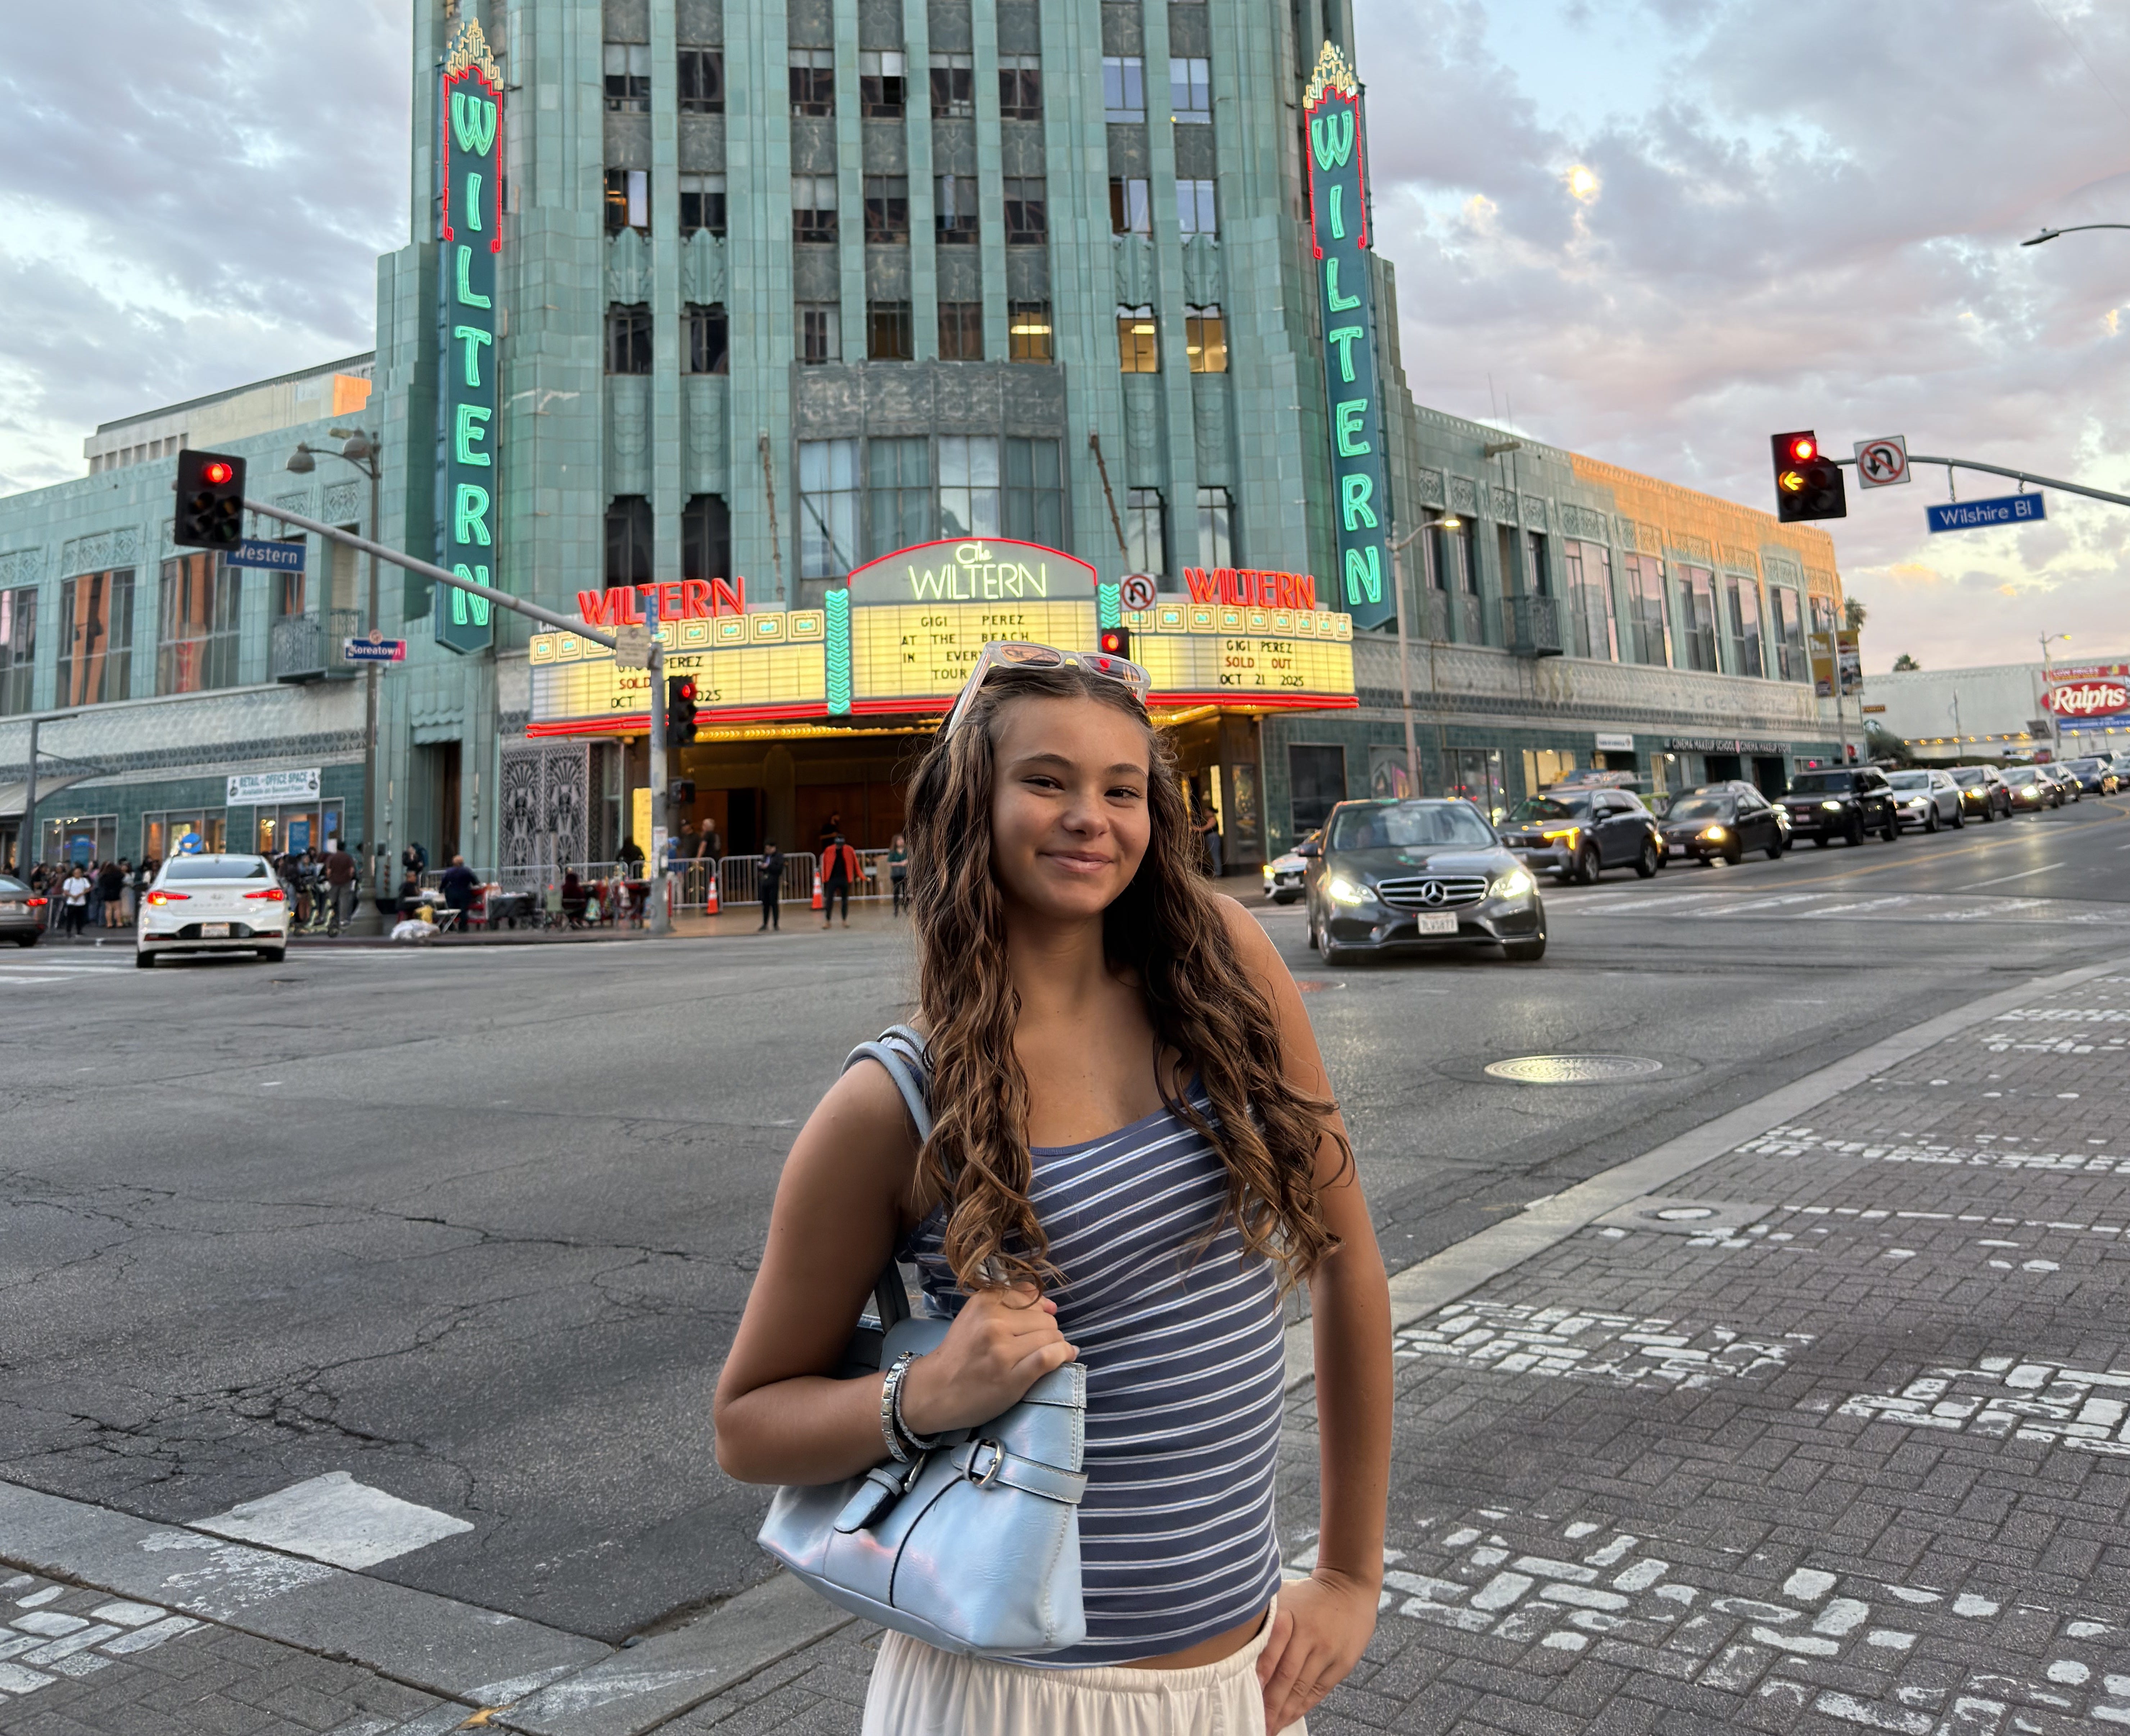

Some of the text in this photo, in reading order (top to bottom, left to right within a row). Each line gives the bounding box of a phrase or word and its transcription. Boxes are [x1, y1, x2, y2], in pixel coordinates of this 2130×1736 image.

[451, 91, 497, 626] WILTERN
[1311, 110, 1382, 605] WILTERN
[1940, 500, 2032, 526] Wilshire Bl
[908, 562, 1046, 600] WILTERN
[1184, 568, 1315, 609] WILTERN
[921, 615, 1025, 627] GIGI PEREZ
[902, 635, 917, 645] AT
[931, 634, 957, 644] THE
[1226, 639, 1292, 654] GIGI PEREZ
[903, 651, 982, 663] IN EVER
[1225, 656, 1292, 670] SOLD OUT
[931, 668, 968, 680] TOUR
[1220, 673, 1304, 686] OCT 21 2025
[611, 689, 722, 708] OCT 025
[2053, 684, 2126, 714] Ralphs
[1672, 738, 1692, 751] CINEMA
[1693, 739, 1714, 752] MAKEUP
[1715, 739, 1735, 753] SCHOOL
[1740, 740, 1759, 753] CINEMA
